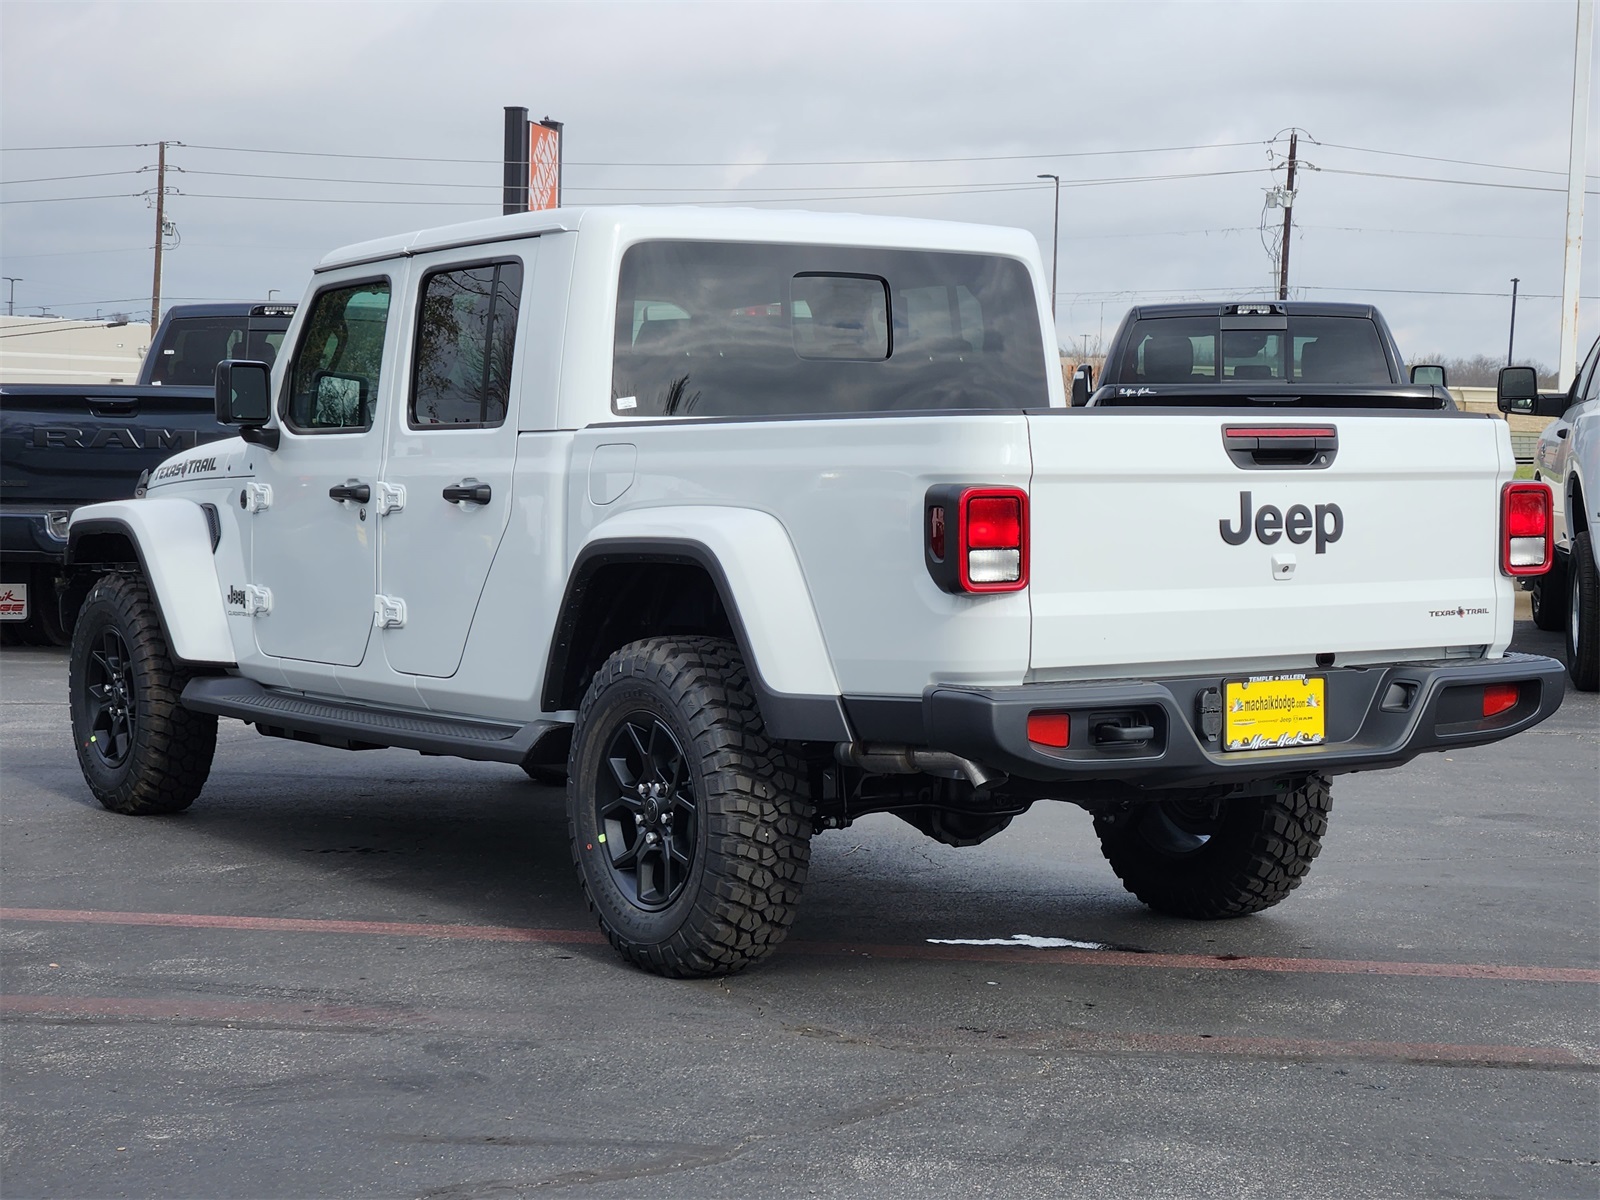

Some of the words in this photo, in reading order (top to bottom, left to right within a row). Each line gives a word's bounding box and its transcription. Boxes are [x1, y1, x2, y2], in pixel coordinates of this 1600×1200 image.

[533, 132, 545, 163] THE
[529, 130, 557, 209] HOME
[33, 427, 197, 448] RAM
[155, 463, 182, 480] TEXAS
[188, 457, 217, 474] TRAIL
[1219, 491, 1344, 554] Jeep
[1249, 675, 1274, 683] TEMPLE
[1280, 673, 1306, 681] KILLEEN
[1244, 695, 1306, 712] machaikdodge.com
[1249, 733, 1277, 749] Mac
